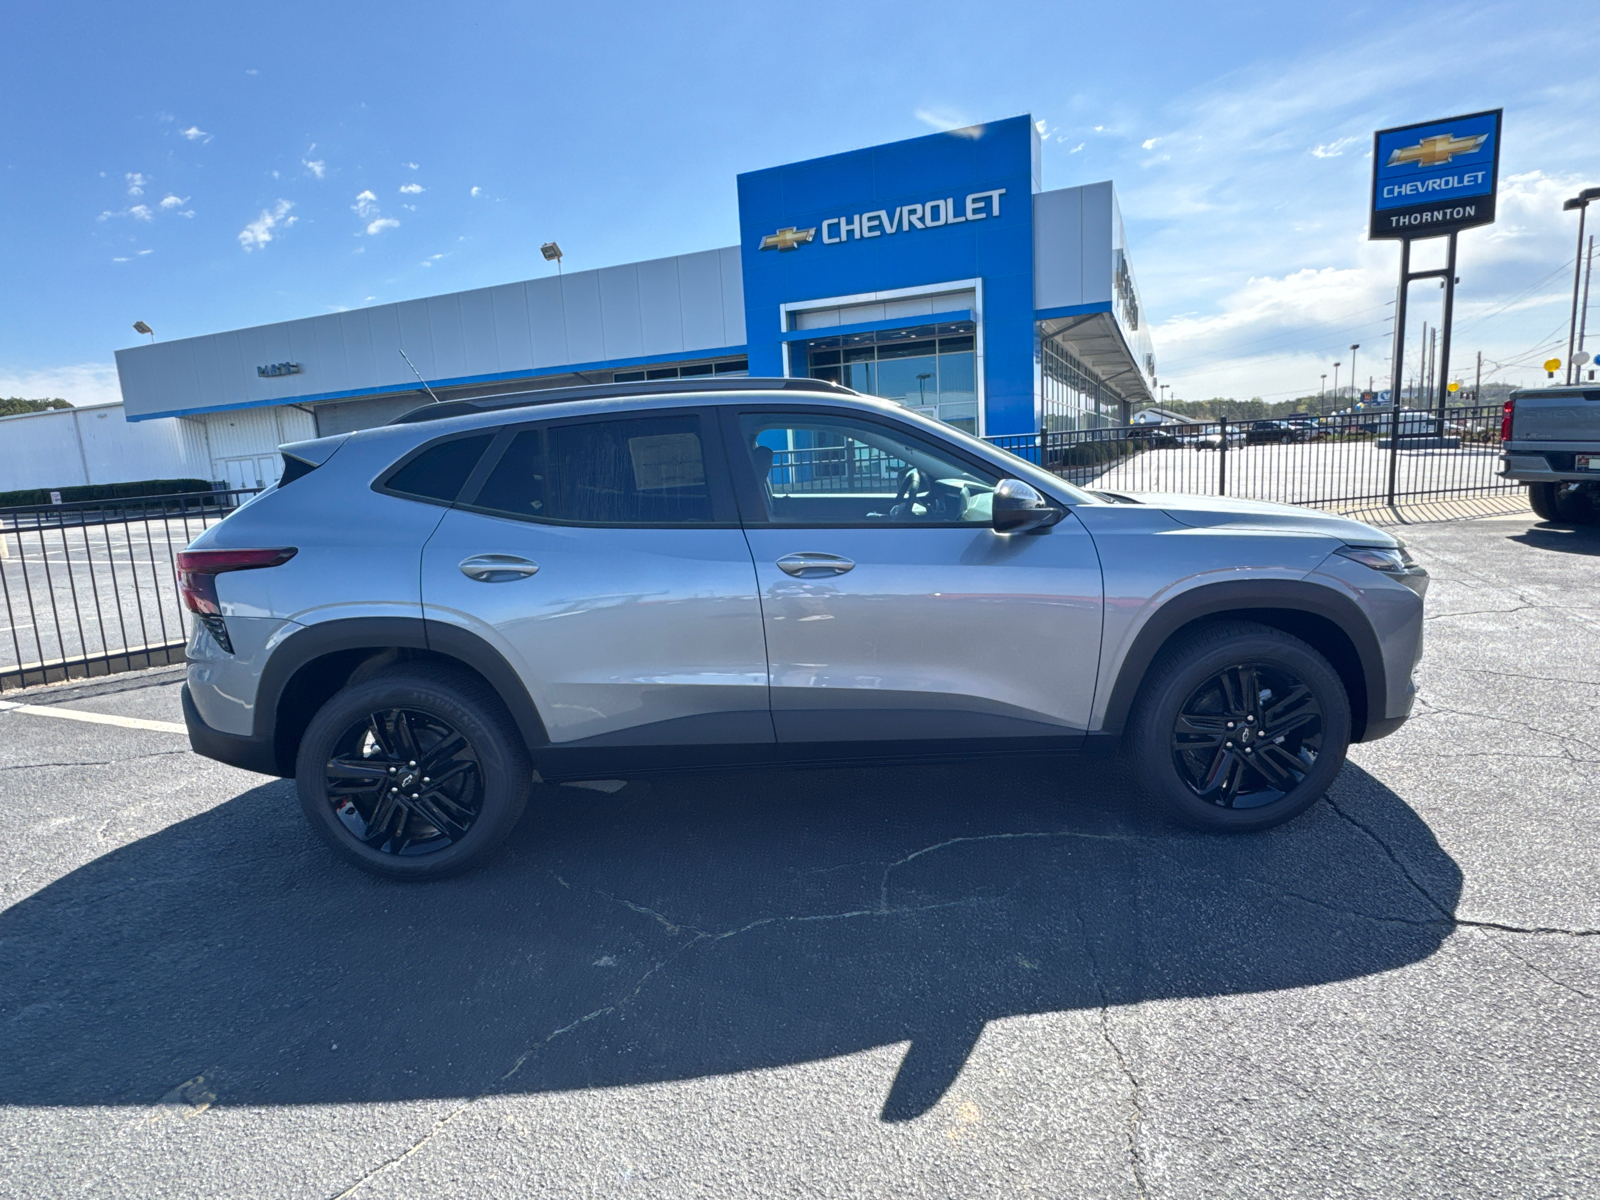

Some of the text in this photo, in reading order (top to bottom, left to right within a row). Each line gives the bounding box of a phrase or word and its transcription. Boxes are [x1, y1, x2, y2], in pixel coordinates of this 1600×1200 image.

[1383, 171, 1486, 198] CHEVROLET
[821, 188, 1006, 244] CHEVROLET
[1390, 205, 1476, 227] THORNTON
